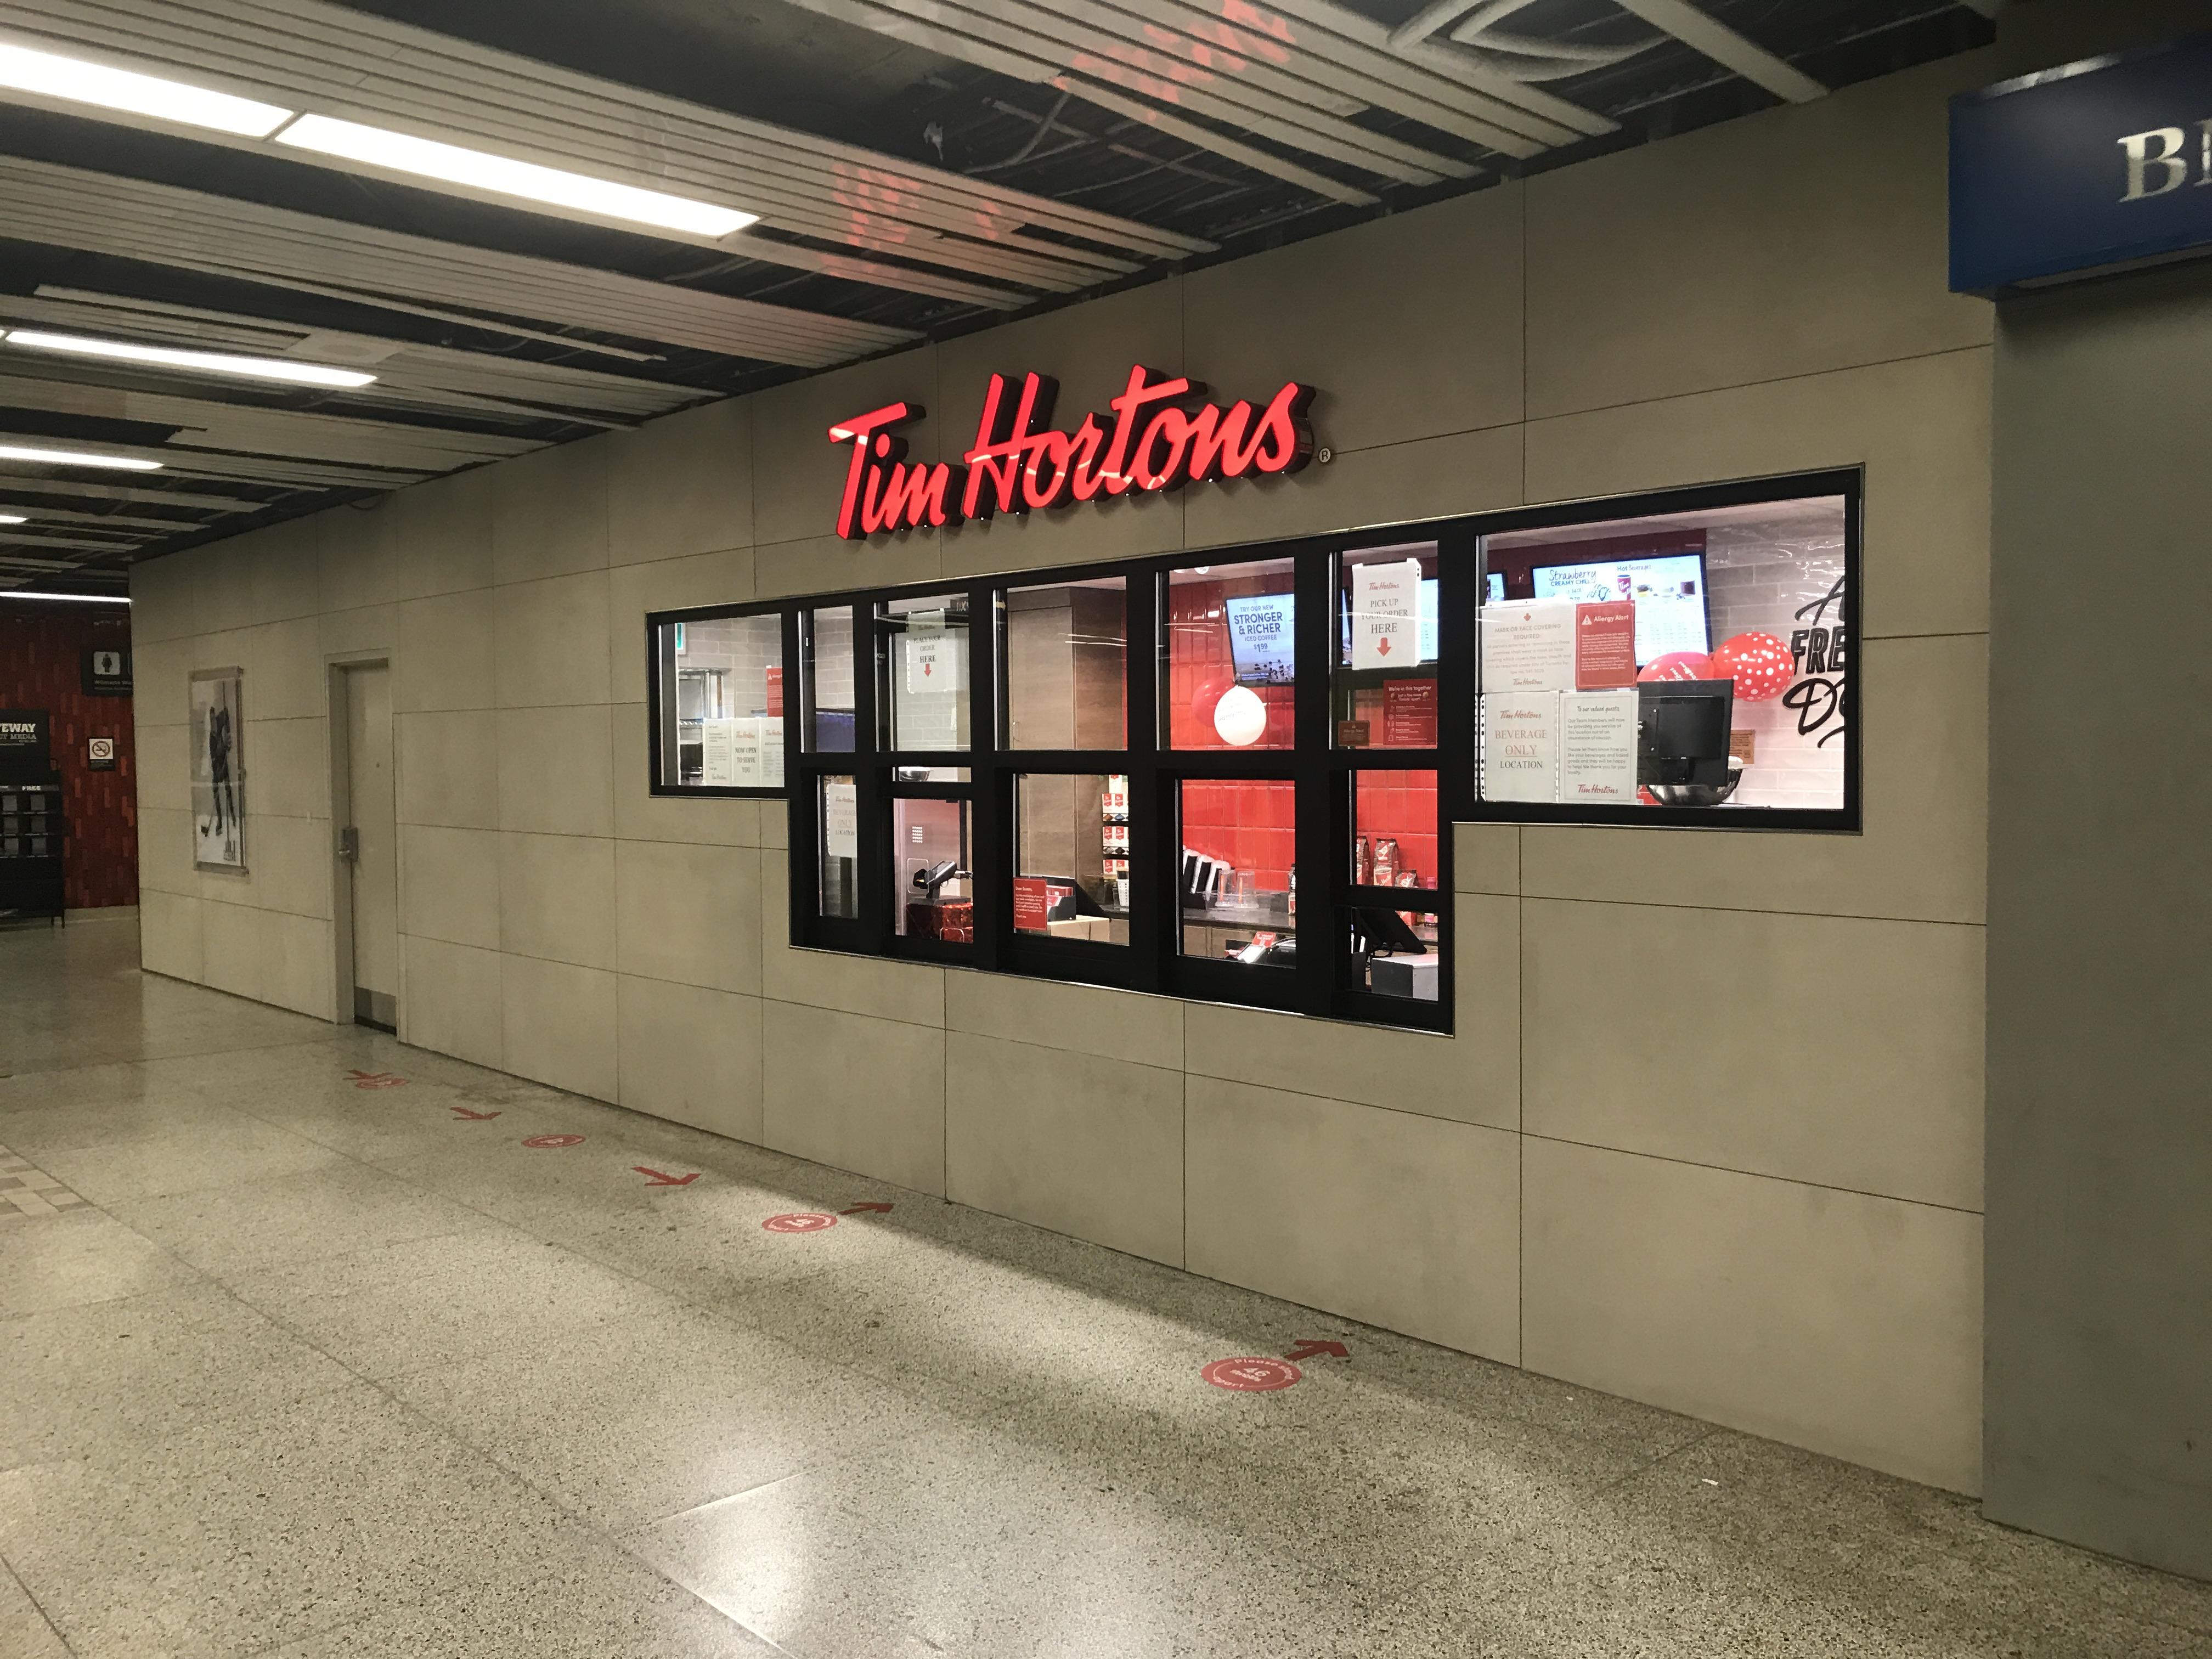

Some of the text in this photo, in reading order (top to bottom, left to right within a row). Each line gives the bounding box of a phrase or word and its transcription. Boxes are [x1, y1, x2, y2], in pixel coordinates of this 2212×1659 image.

[828, 402, 956, 540] Tim
[964, 364, 1303, 519] Hortons
[1549, 569, 1596, 583] Strawberry
[1369, 582, 1400, 590] Tim Hortons
[1234, 612, 1283, 624] STRONGER
[1383, 610, 1408, 618] ORDER
[1239, 623, 1281, 635] & RICHER
[1371, 623, 1397, 634] HERE
[1500, 710, 1541, 719] Tim Hortons
[0, 723, 36, 732] EWAY
[1495, 730, 1548, 739] BEVERAGE
[1505, 745, 1537, 755] ONLY
[1578, 784, 1618, 794] Tim Hortons
[1234, 1358, 1278, 1367] Please
